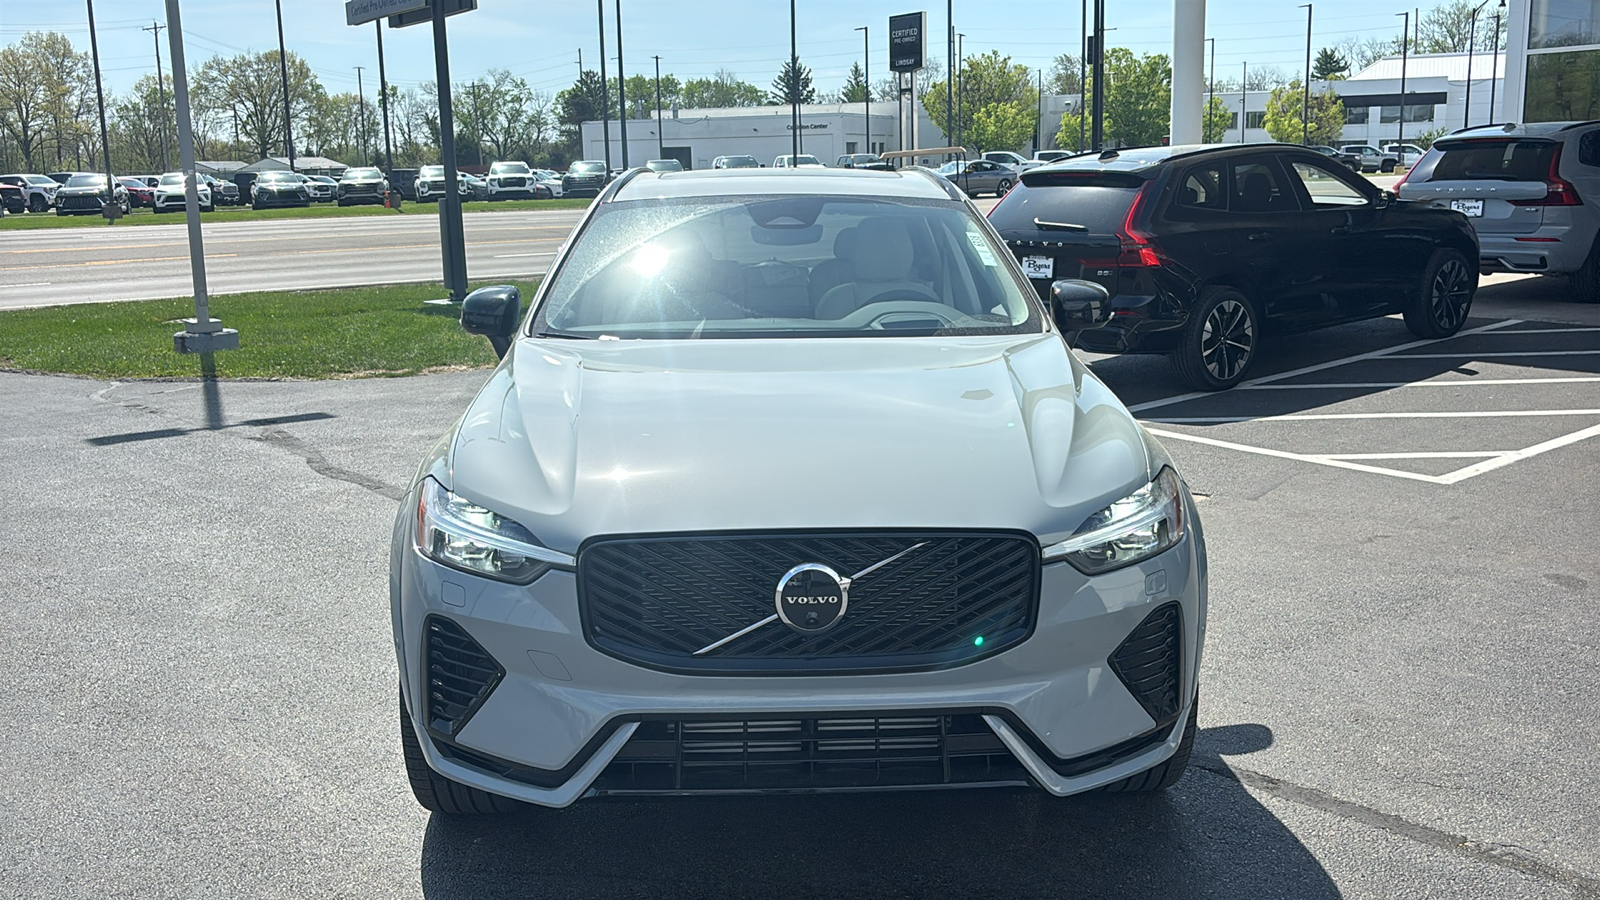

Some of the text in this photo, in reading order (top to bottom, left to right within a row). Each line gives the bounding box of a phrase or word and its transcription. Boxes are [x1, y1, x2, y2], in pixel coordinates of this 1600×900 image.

[351, 2, 369, 17] Certified
[892, 28, 918, 38] CERTIFIED
[894, 36, 916, 44] PRE-OWNED
[895, 58, 915, 67] LINDSAY
[1454, 203, 1480, 212] Byers
[1025, 260, 1051, 272] Byers
[786, 596, 838, 604] VOLVO
